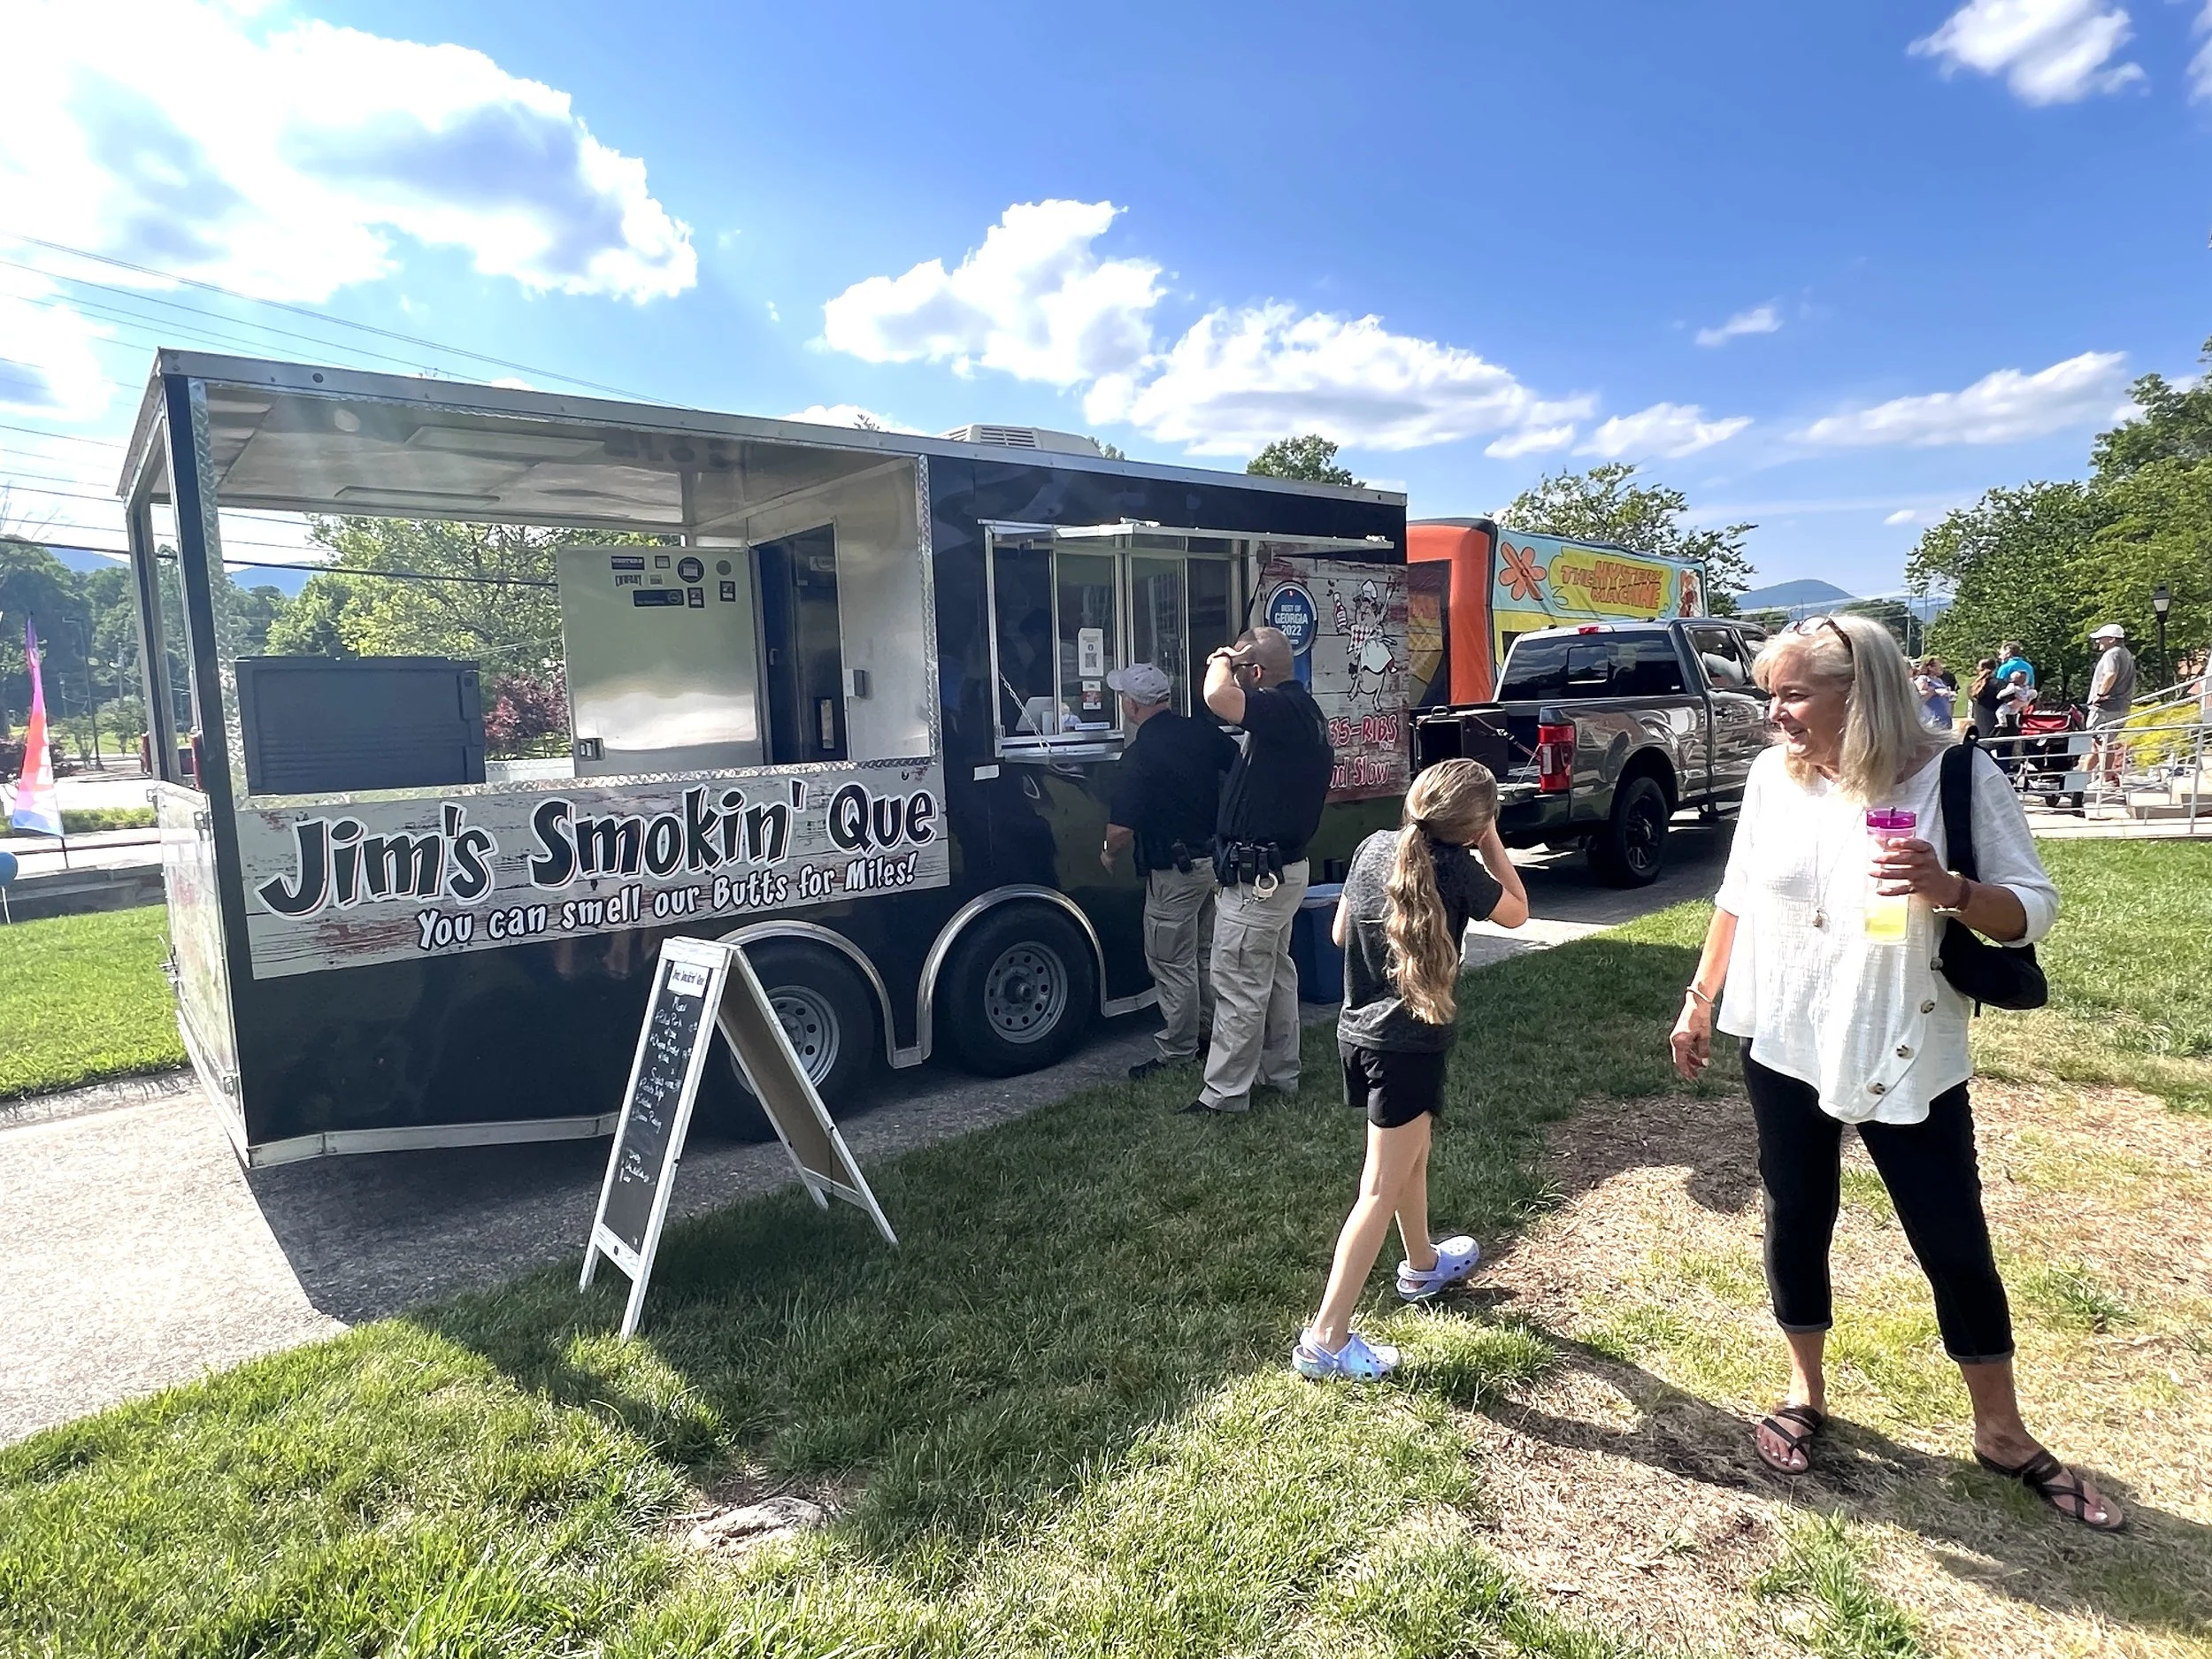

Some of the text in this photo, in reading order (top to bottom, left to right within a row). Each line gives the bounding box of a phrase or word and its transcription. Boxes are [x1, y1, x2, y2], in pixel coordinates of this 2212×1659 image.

[1560, 559, 1663, 589] THE MYSTERY
[1590, 581, 1662, 610] MACHINE
[1274, 612, 1309, 625] GEORGIA
[1281, 624, 1302, 636] 2022
[1328, 714, 1398, 747] 35-RIBS
[1329, 755, 1390, 788] nd Slow
[257, 775, 938, 918] Jim's Smokin' Que
[418, 850, 918, 951] You can smell our Butts for Miles!
